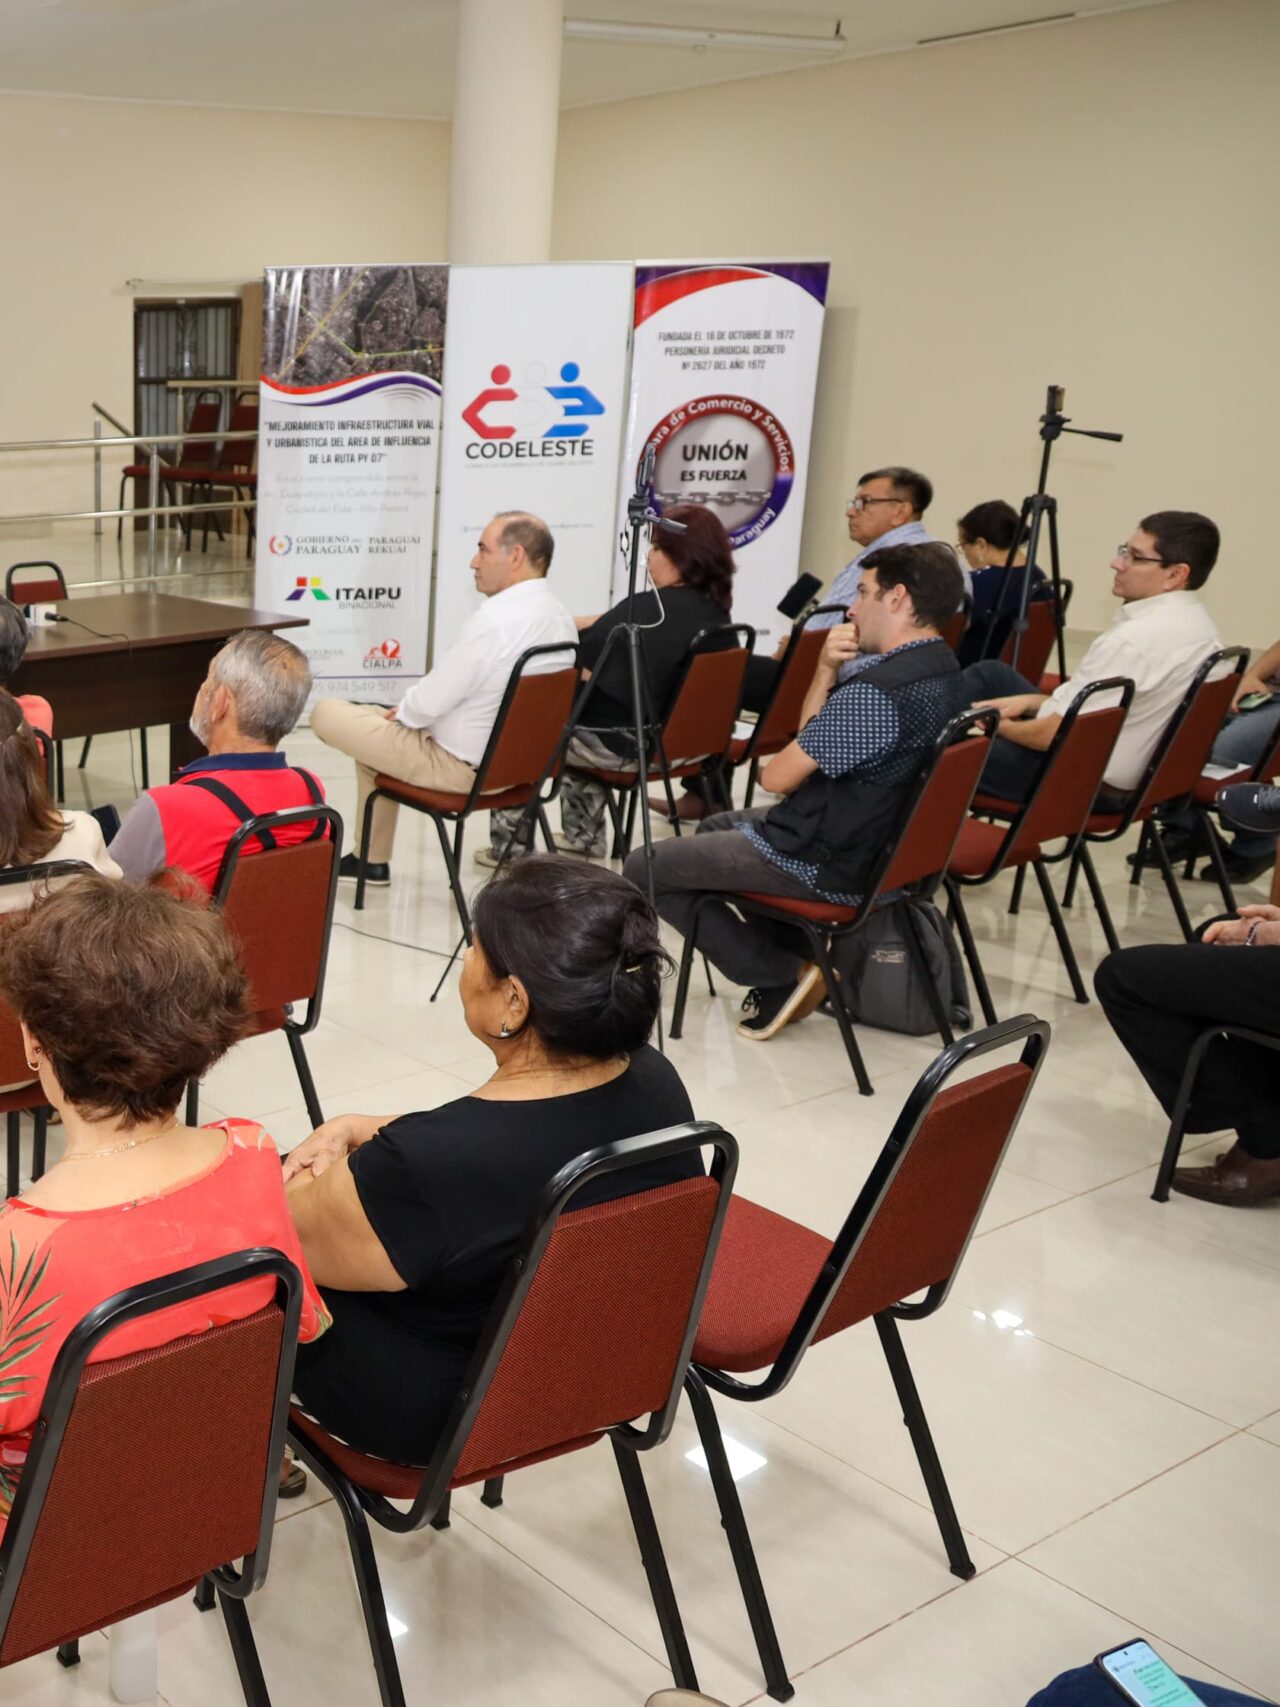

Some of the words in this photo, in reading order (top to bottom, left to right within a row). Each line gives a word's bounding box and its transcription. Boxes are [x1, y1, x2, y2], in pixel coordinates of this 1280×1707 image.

[659, 331, 692, 341] FUNDADA
[694, 331, 703, 340] EL
[717, 331, 726, 340] DE
[728, 330, 761, 340] OCTUBRE
[763, 330, 772, 339] DE
[714, 361, 727, 370] DEL
[337, 420, 414, 431] INFRAESTRUCTURA
[417, 419, 435, 430] VIAL
[670, 412, 686, 426] de
[688, 398, 753, 415] Comercio
[751, 409, 764, 420] y
[761, 414, 793, 473] Servicios
[331, 437, 345, 447] DEL
[371, 437, 381, 446] DE
[384, 436, 431, 447] INFLUENCIA
[465, 439, 594, 460] CODELESTE
[682, 439, 749, 462] UNIÓN
[309, 454, 319, 464] DE
[321, 454, 332, 463] LA
[334, 453, 355, 463] RUTA
[358, 453, 368, 463] PY
[680, 470, 695, 482] ES
[698, 470, 747, 482] FUERZA
[729, 507, 776, 546] Paraguay
[296, 536, 349, 544] GOBIERNO
[296, 545, 362, 555] PARAGUAY
[336, 587, 401, 600] ITAIPU
[339, 601, 396, 609] BINACIONAL
[363, 659, 402, 669] CIALPA
